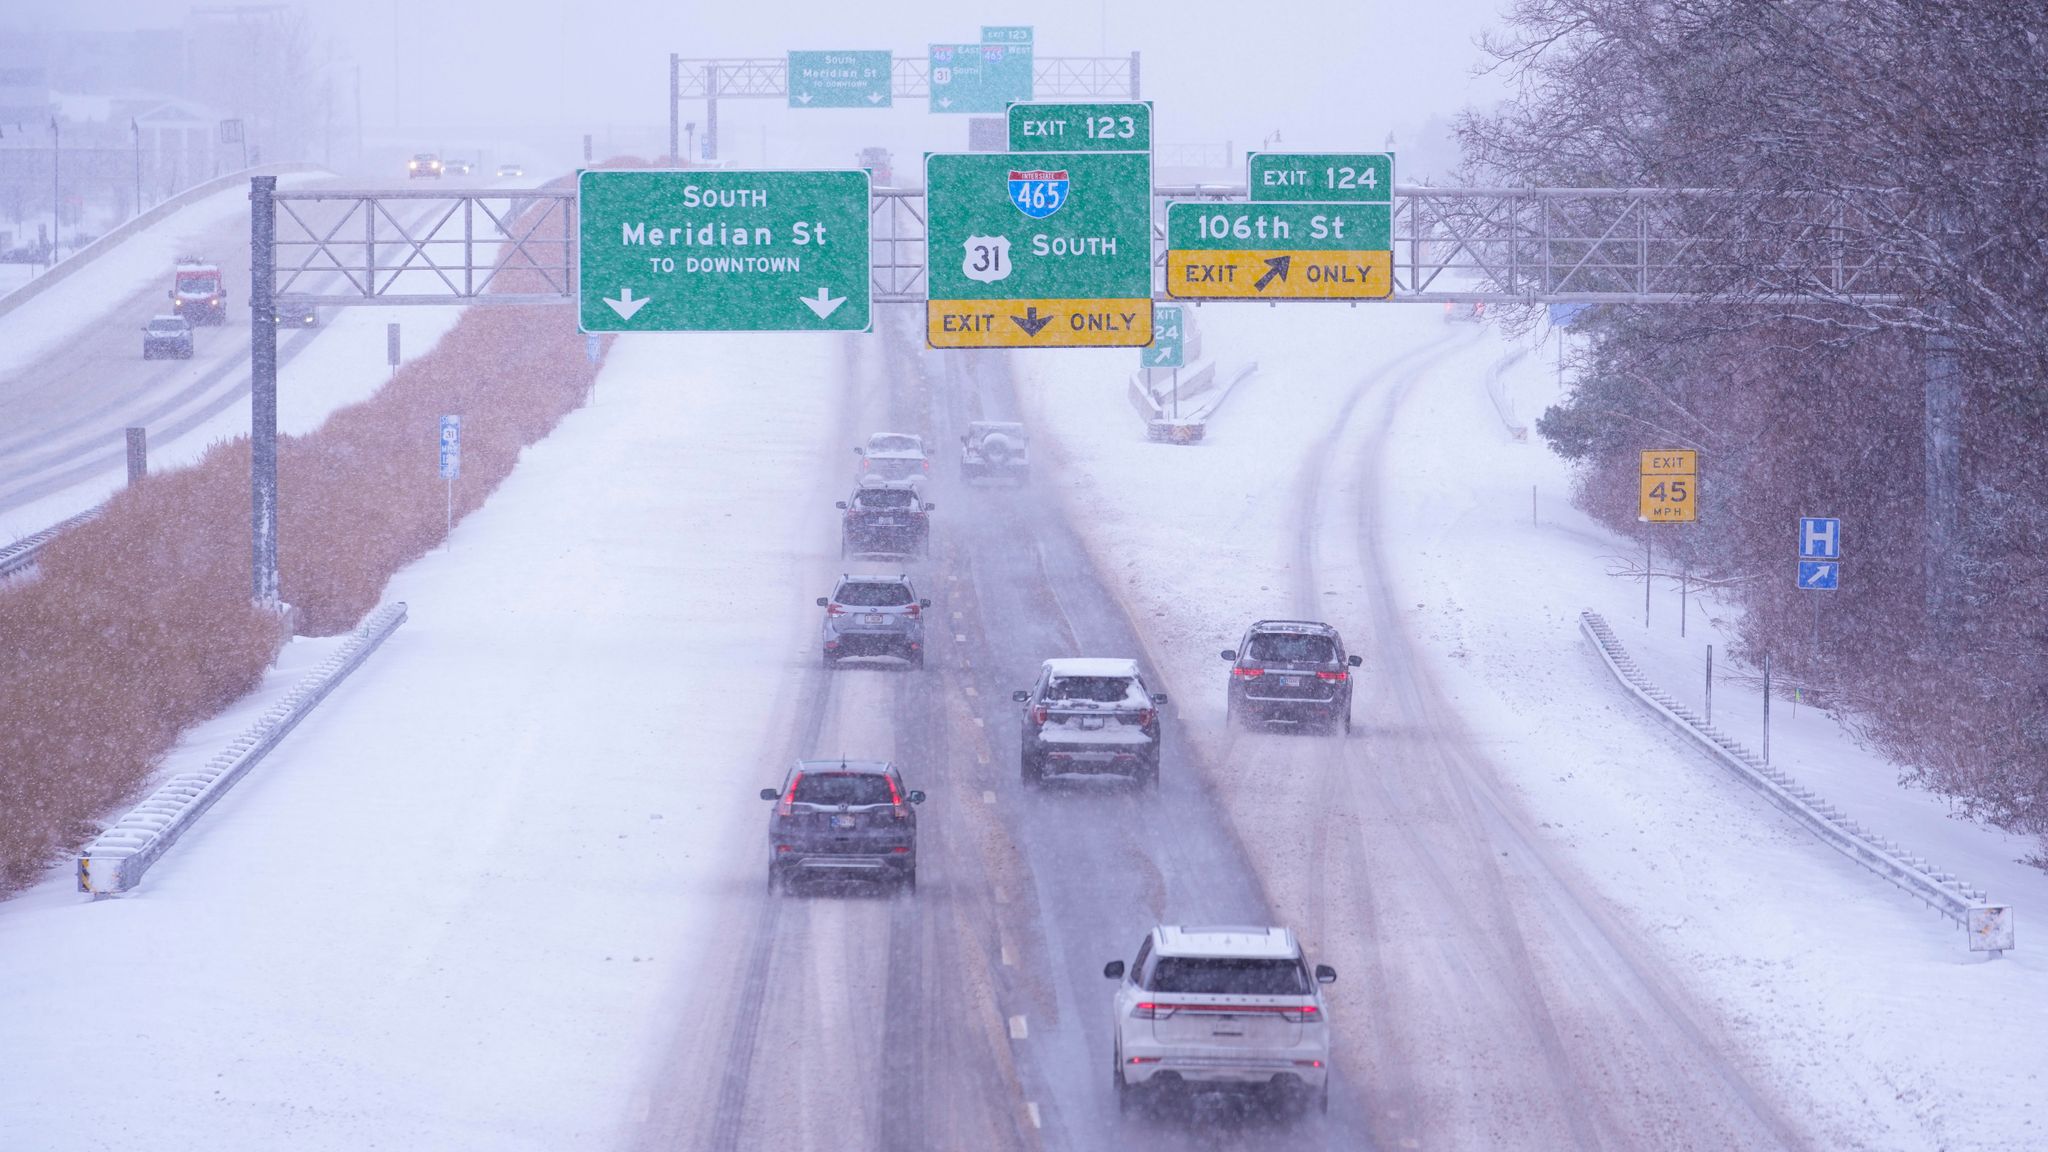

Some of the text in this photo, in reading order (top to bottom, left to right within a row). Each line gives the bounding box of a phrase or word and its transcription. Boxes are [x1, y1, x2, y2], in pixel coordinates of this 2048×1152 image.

[1008, 30, 1027, 39] 123
[984, 52, 1002, 60] 465
[803, 68, 877, 78] Meridian St
[937, 72, 948, 81] 31
[1024, 117, 1135, 138] EXIT 123
[1264, 167, 1377, 190] EXIT 124
[683, 185, 767, 208] SOUTH
[1018, 182, 1059, 208] 465
[622, 222, 827, 246] Meridian St
[1199, 215, 1345, 240] 106th St
[1032, 234, 1117, 256] SOUTH
[649, 257, 800, 273] TO DOWNTOWN
[972, 245, 1000, 272] 31
[1186, 264, 1372, 283] EXIT ONLY
[943, 313, 1136, 332] EXIT ONLY
[1156, 309, 1177, 320] XIT
[1155, 325, 1179, 340] 24
[1653, 457, 1685, 469] EXIT
[1649, 481, 1687, 503] 45
[1653, 507, 1682, 517] MPH
[1805, 521, 1834, 556] H
